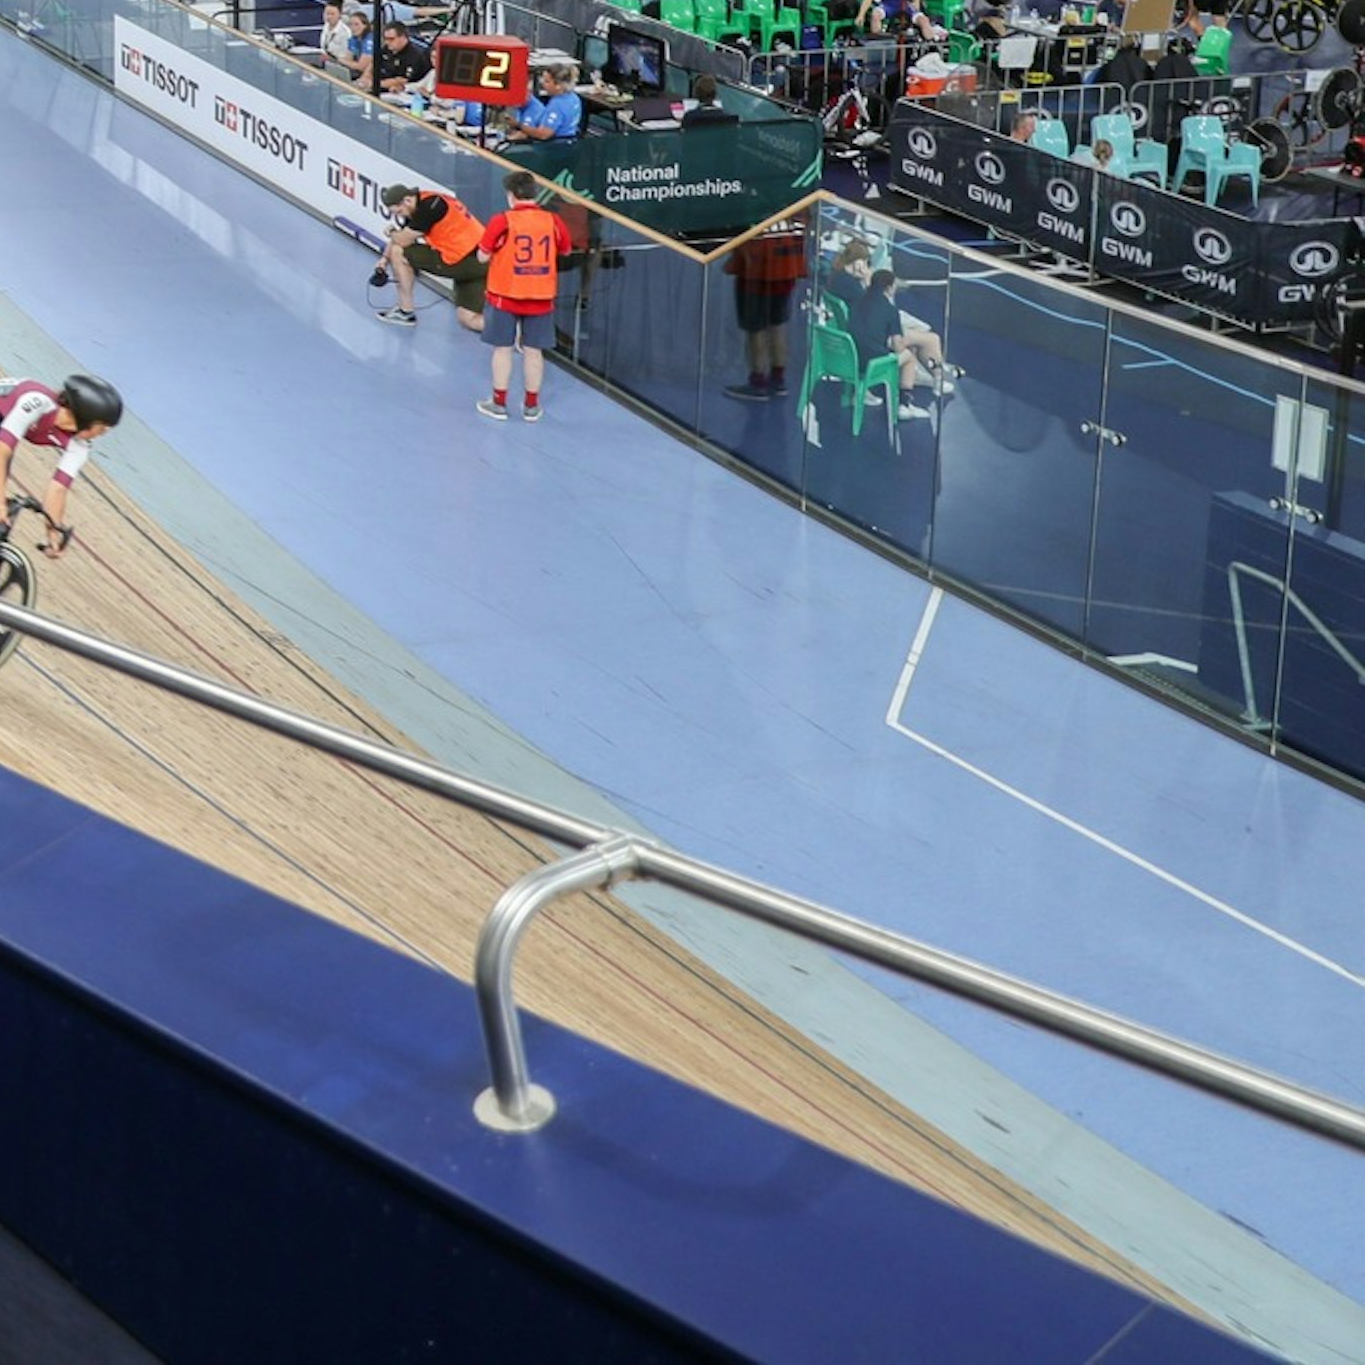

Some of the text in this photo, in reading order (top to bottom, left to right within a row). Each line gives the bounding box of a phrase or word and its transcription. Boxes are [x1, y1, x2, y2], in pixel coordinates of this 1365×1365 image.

[141, 54, 200, 109] TISSOT
[480, 51, 510, 89] 2
[240, 110, 309, 172] TISSOT
[606, 162, 681, 183] National
[902, 159, 945, 188] GWM
[606, 179, 742, 203] Championships
[968, 183, 1013, 215] GWM
[1037, 211, 1085, 245] GWM
[514, 235, 550, 263] 31
[1102, 238, 1153, 267] GWM
[1181, 263, 1237, 296] GWM
